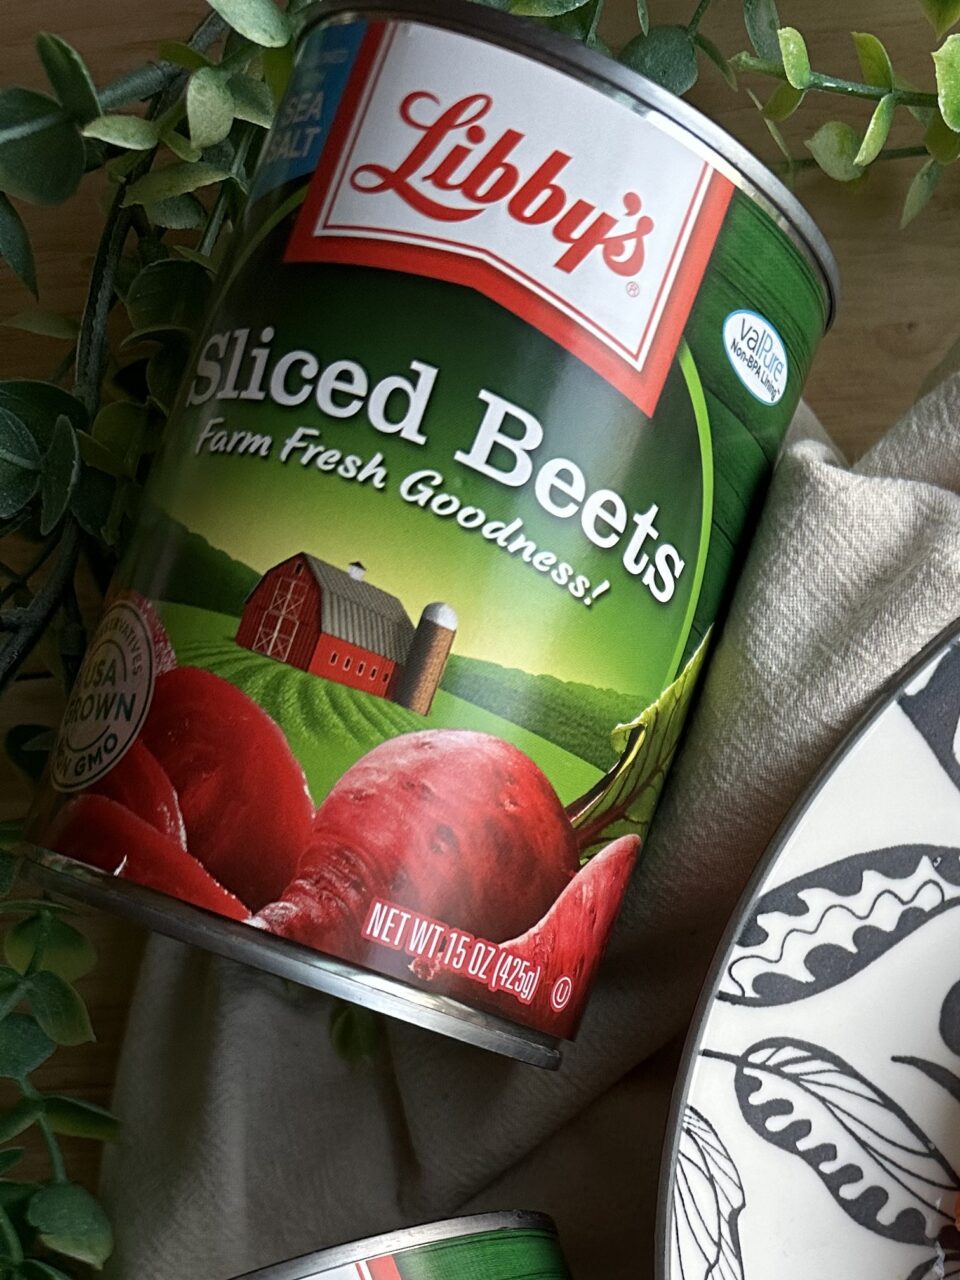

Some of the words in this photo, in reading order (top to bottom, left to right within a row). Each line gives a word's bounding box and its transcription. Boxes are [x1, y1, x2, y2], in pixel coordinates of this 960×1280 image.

[351, 91, 655, 277] Libby's
[730, 338, 762, 379] Non-BPA
[740, 317, 785, 382] valPure
[187, 326, 440, 446] Sliced
[453, 388, 686, 603] Beets
[196, 416, 273, 457] Farm
[279, 426, 389, 489] Fresh
[399, 469, 611, 606] Goodness!
[84, 659, 117, 689] USA
[74, 733, 118, 776] GMO
[366, 902, 411, 946] NET
[408, 918, 445, 959] WT
[443, 932, 471, 970] 15
[468, 942, 497, 980] OZ
[492, 952, 541, 1001] (425g)
